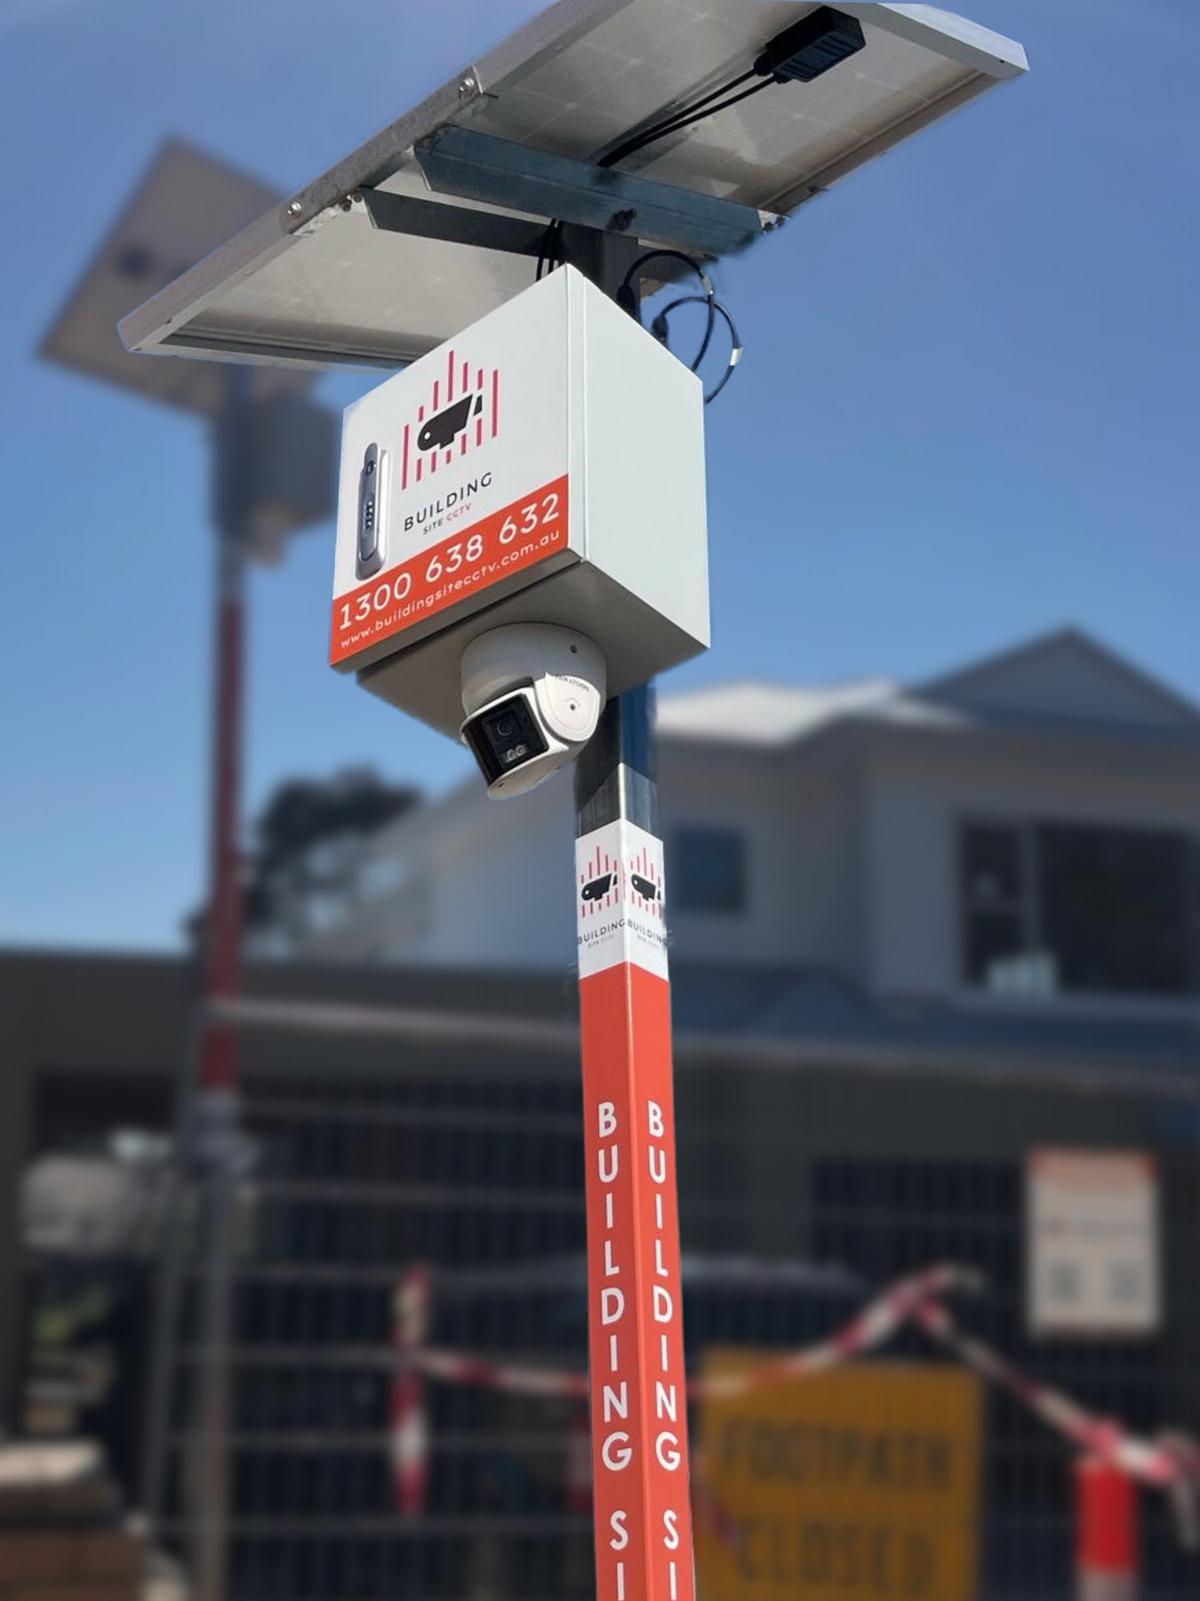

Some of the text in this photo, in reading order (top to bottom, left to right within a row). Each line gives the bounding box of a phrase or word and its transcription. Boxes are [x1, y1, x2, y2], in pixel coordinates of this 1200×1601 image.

[339, 492, 560, 631] 1300 638 632
[404, 471, 492, 532] BUILDING
[423, 502, 471, 535] SITE CCTV
[340, 529, 561, 649] www.buildingsitecctv.com.au
[578, 917, 626, 946] BUILDING
[598, 1101, 633, 1471] BUILDING
[647, 1100, 681, 1471] BUILDING
